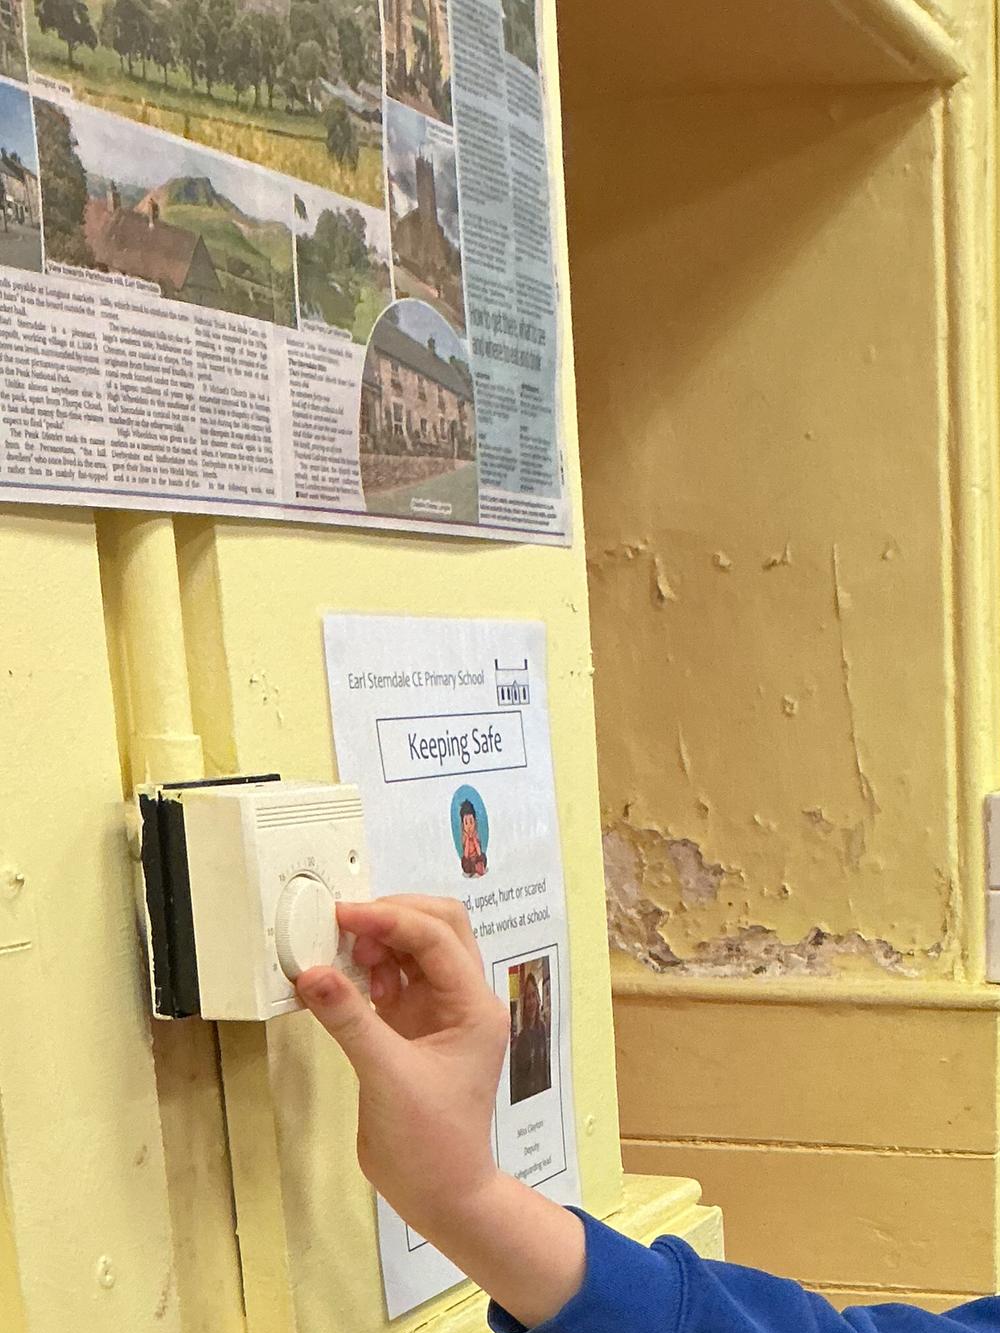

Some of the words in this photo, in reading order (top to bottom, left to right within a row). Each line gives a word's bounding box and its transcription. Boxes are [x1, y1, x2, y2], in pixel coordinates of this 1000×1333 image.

[348, 673, 366, 689] Earl
[369, 672, 410, 689] Sterndale
[412, 671, 423, 686] CE
[425, 671, 456, 691] Primary
[458, 669, 485, 686] School
[408, 729, 471, 766] Keeping
[471, 725, 503, 755] Safe
[475, 892, 499, 912] upset,
[498, 886, 517, 902] hurt
[515, 888, 524, 899] or
[524, 878, 547, 898] scared
[479, 921, 495, 938] that
[496, 914, 518, 932] works
[519, 913, 527, 927] at
